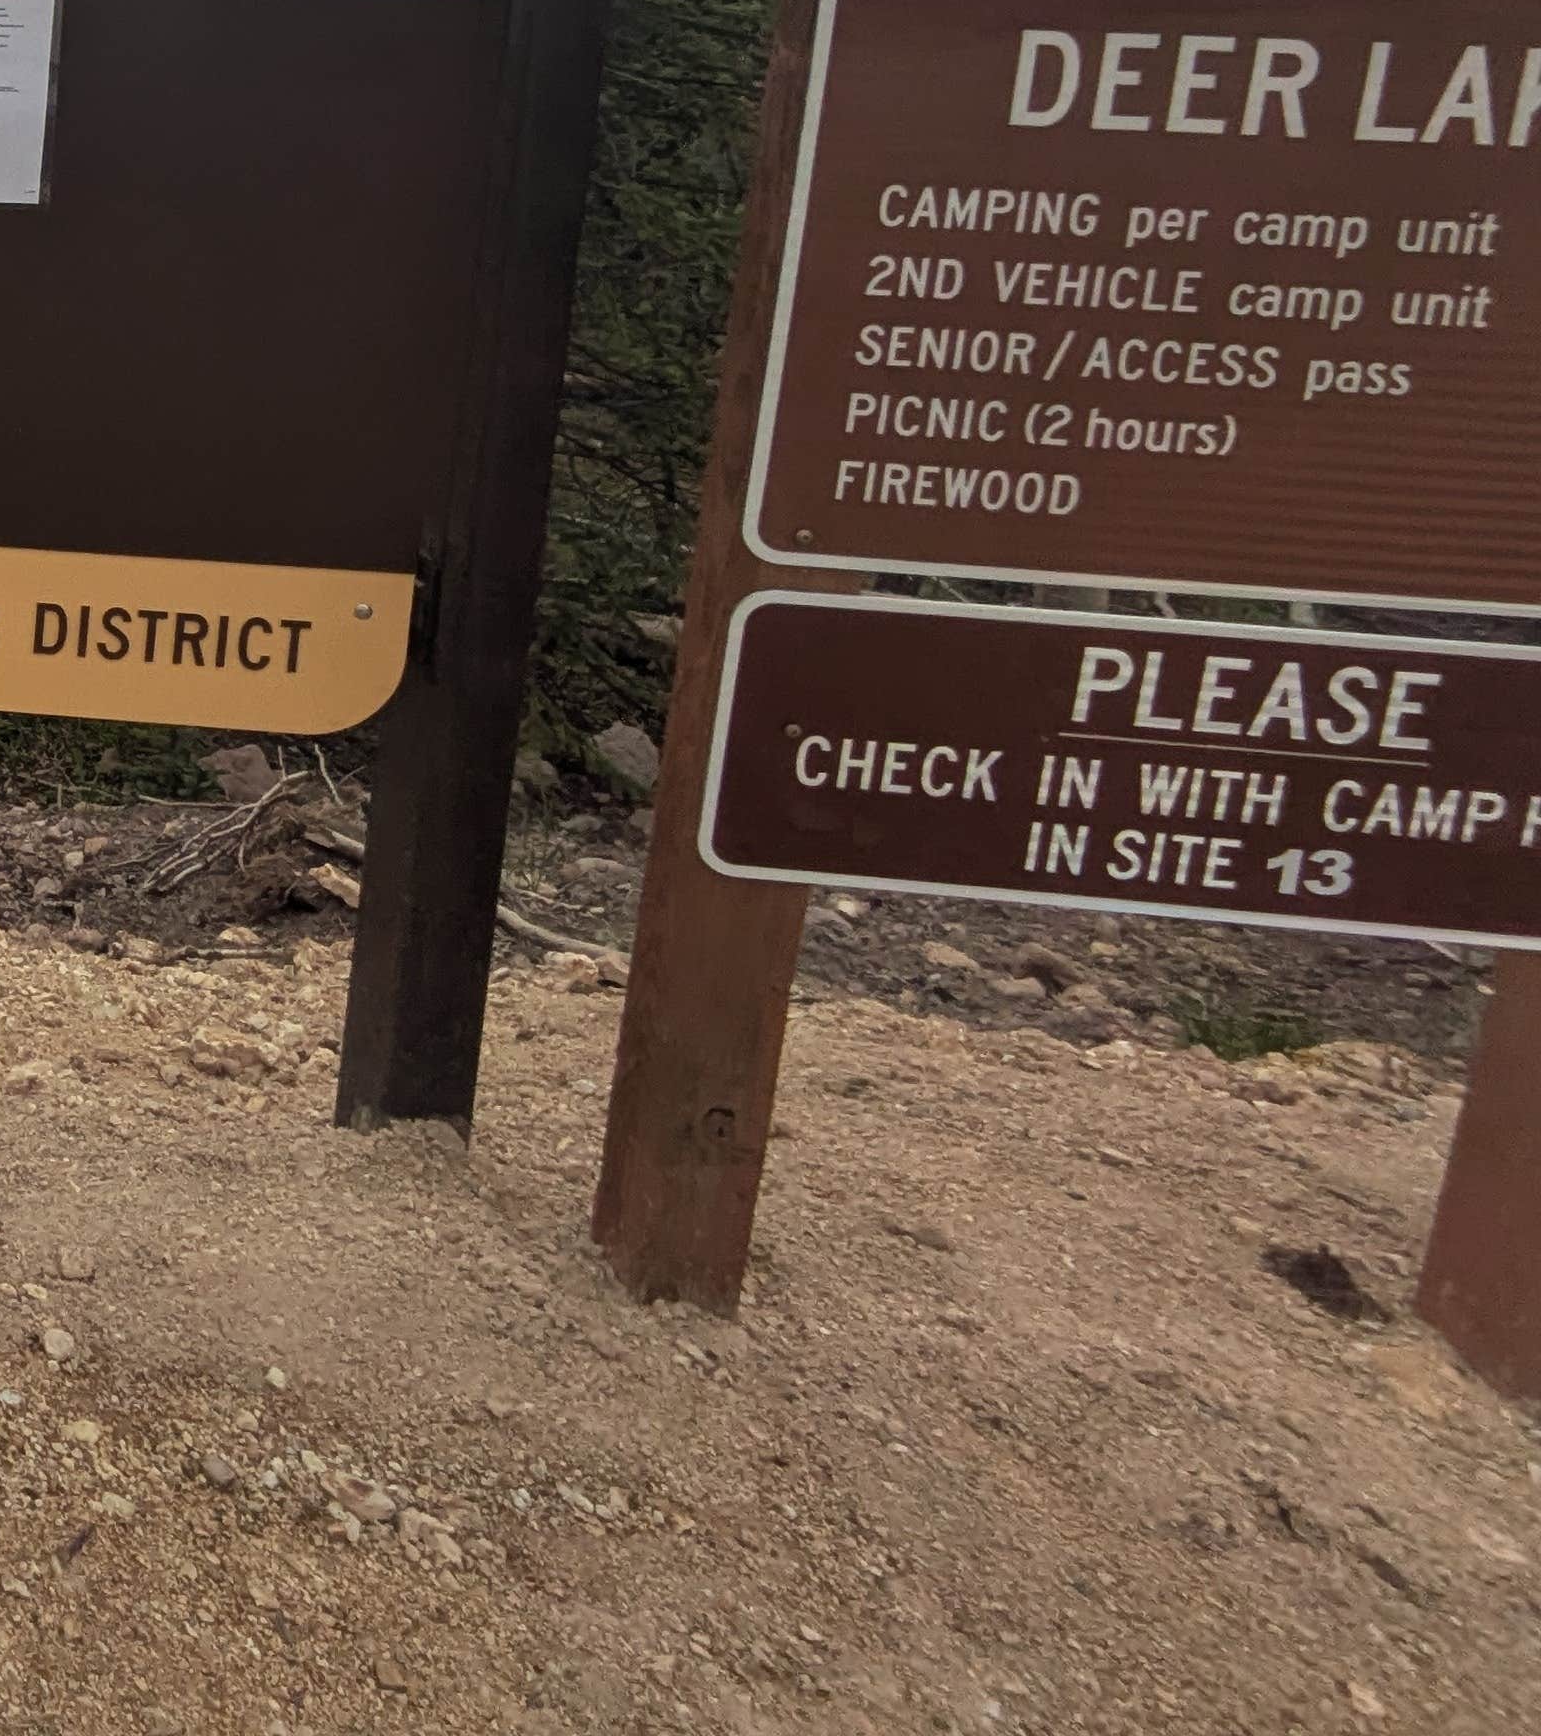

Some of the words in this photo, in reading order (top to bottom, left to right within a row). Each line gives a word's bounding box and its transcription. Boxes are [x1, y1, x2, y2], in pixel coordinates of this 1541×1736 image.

[1008, 28, 1322, 140] DEER
[878, 184, 1101, 238] CAMPING
[1125, 205, 1210, 249] per
[1233, 209, 1369, 260] camp
[1398, 211, 1501, 256] unit
[864, 256, 965, 301] 2ND
[995, 260, 1203, 315] VEHICLE
[1228, 281, 1363, 331] camp
[1390, 285, 1492, 329] unit
[1303, 354, 1413, 402] pass
[844, 393, 1007, 444] PICNIC
[1024, 402, 1071, 447] (2
[1084, 408, 1238, 458] hours)
[834, 460, 1082, 517] FIREWOOD
[31, 601, 313, 675] DISTRICT
[1070, 646, 1444, 752] PLEASE
[794, 733, 1004, 803] CHECK
[1036, 754, 1102, 811] IN
[1139, 762, 1287, 827] WITH
[1323, 779, 1507, 848] CAMP
[1023, 820, 1089, 876] IN
[1105, 828, 1243, 889] SITE
[1265, 848, 1354, 897] 13
